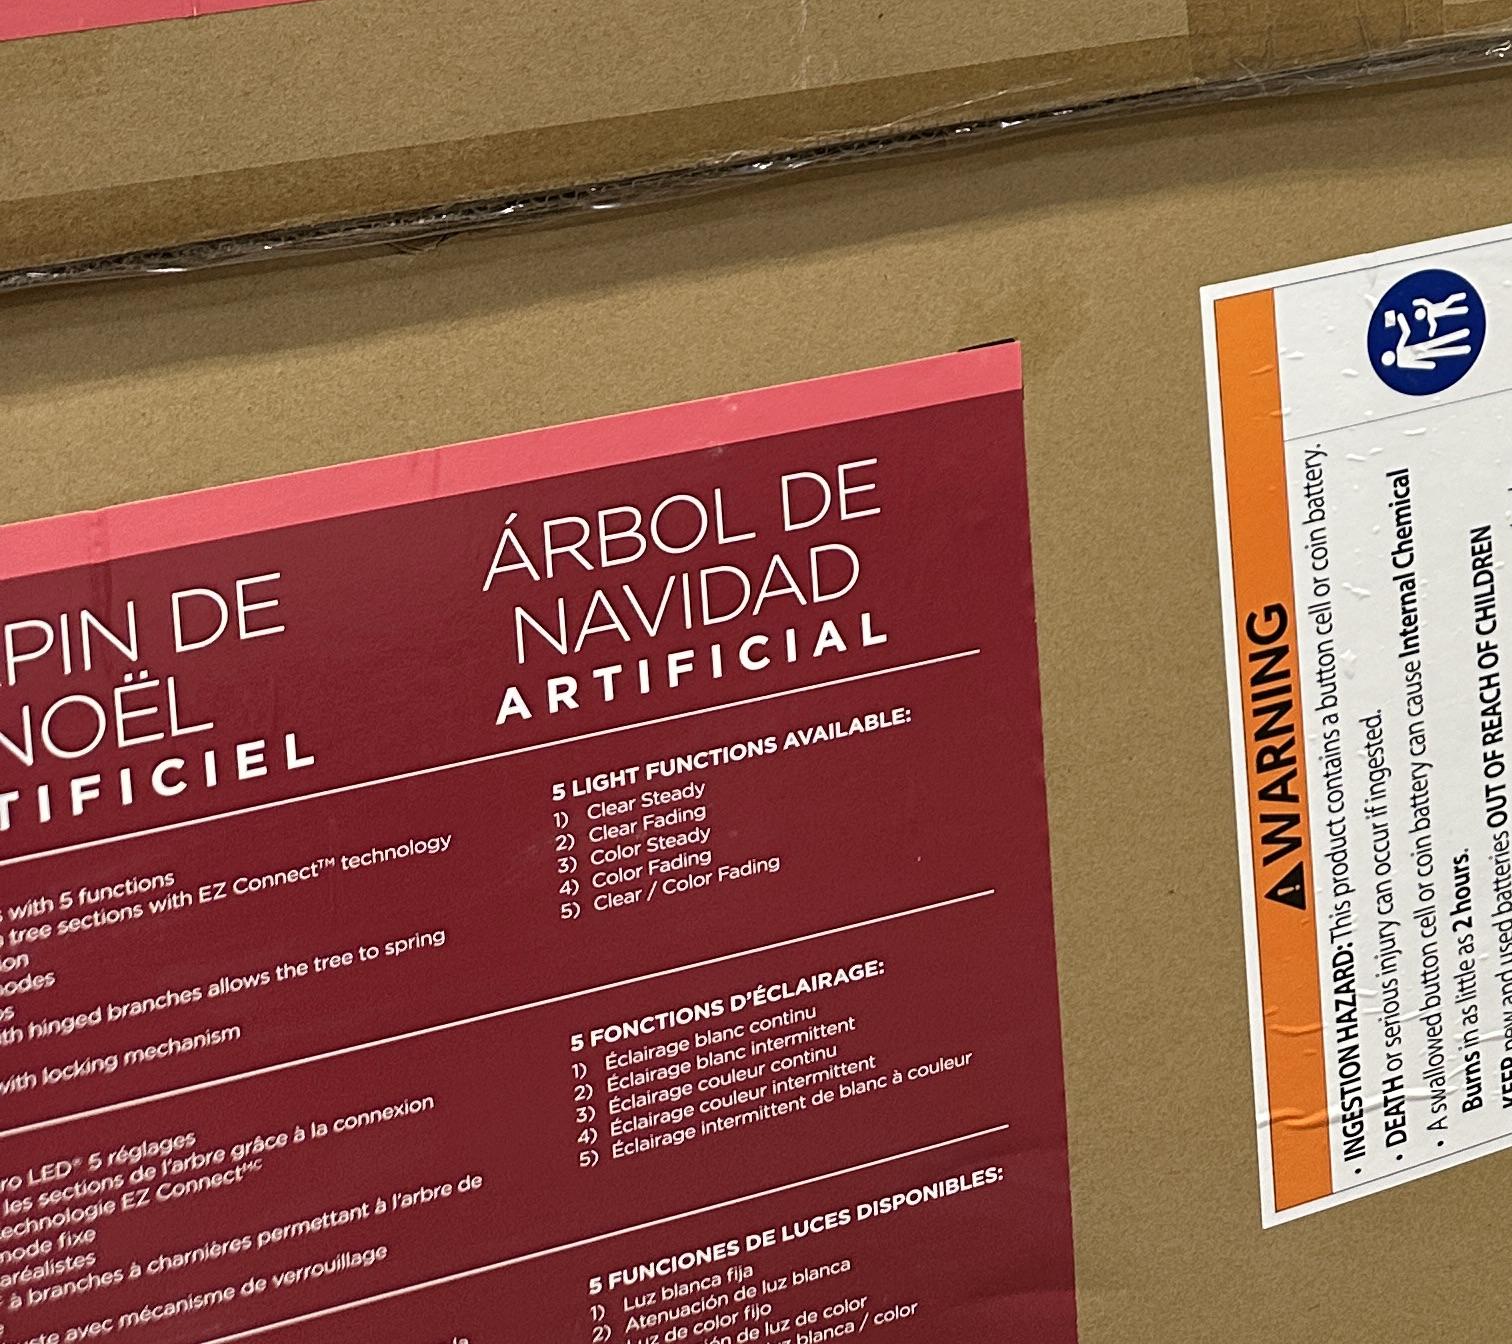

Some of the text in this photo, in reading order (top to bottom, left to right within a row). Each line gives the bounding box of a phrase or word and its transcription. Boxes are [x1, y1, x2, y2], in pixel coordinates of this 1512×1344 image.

[483, 459, 880, 591] ÁRBOL DE
[171, 572, 285, 653] DE
[515, 544, 859, 663] NAVIDAD
[496, 613, 887, 725] ARTIFICIAL
[553, 708, 911, 801] 5 LIGHT FUNCTIONS AVAILABLE:
[1247, 603, 1304, 867] WARNING
[571, 960, 884, 1051] 5 FONCTIONS D’ÉCLAIRAGE:
